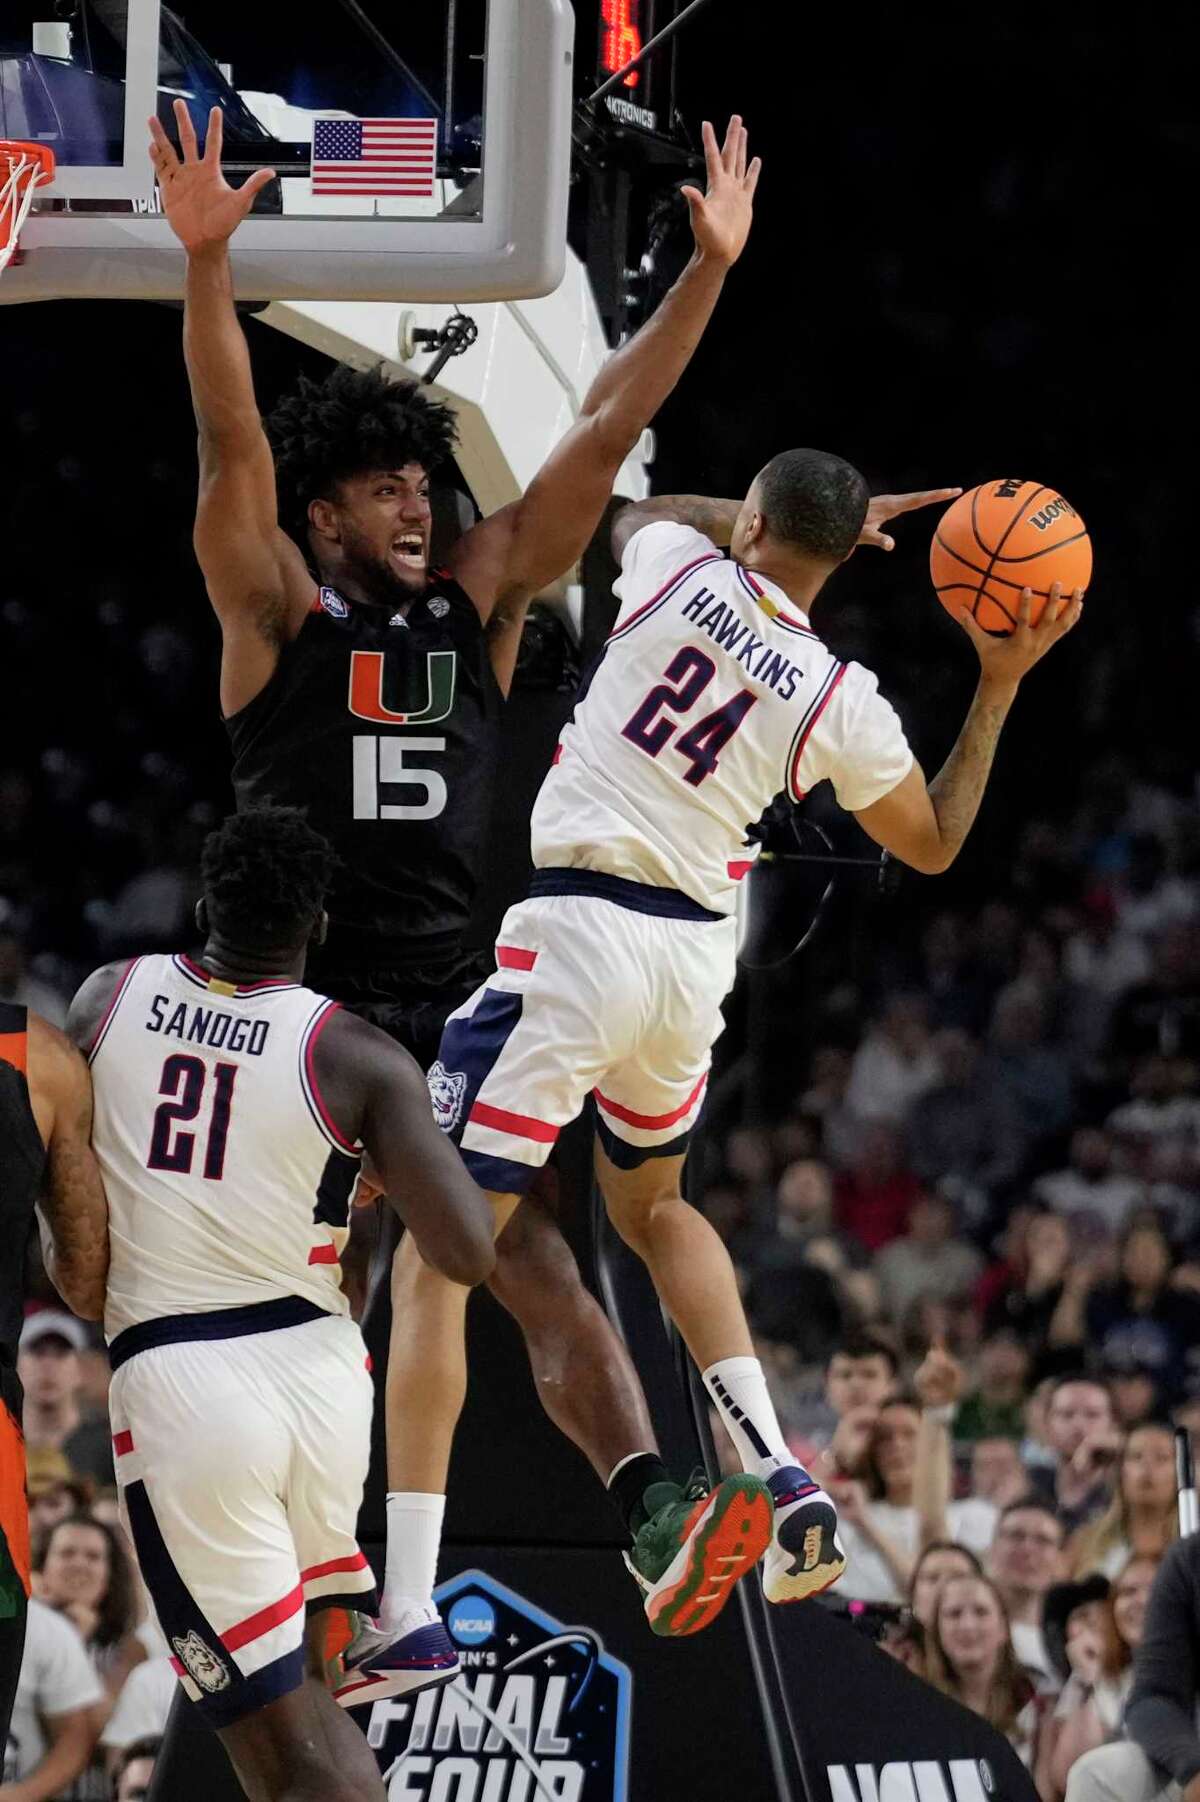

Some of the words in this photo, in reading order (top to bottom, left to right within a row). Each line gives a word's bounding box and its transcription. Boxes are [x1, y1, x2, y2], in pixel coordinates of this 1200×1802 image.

[681, 587, 804, 701] HAWKINS
[348, 651, 456, 725] U
[620, 645, 758, 788] 24
[352, 735, 448, 820] 15
[145, 994, 270, 1057] SANOGO
[146, 1053, 239, 1181] 21
[453, 1618, 493, 1633] NCAA
[453, 1651, 498, 1667] EN'S
[367, 1674, 571, 1754] FINAL
